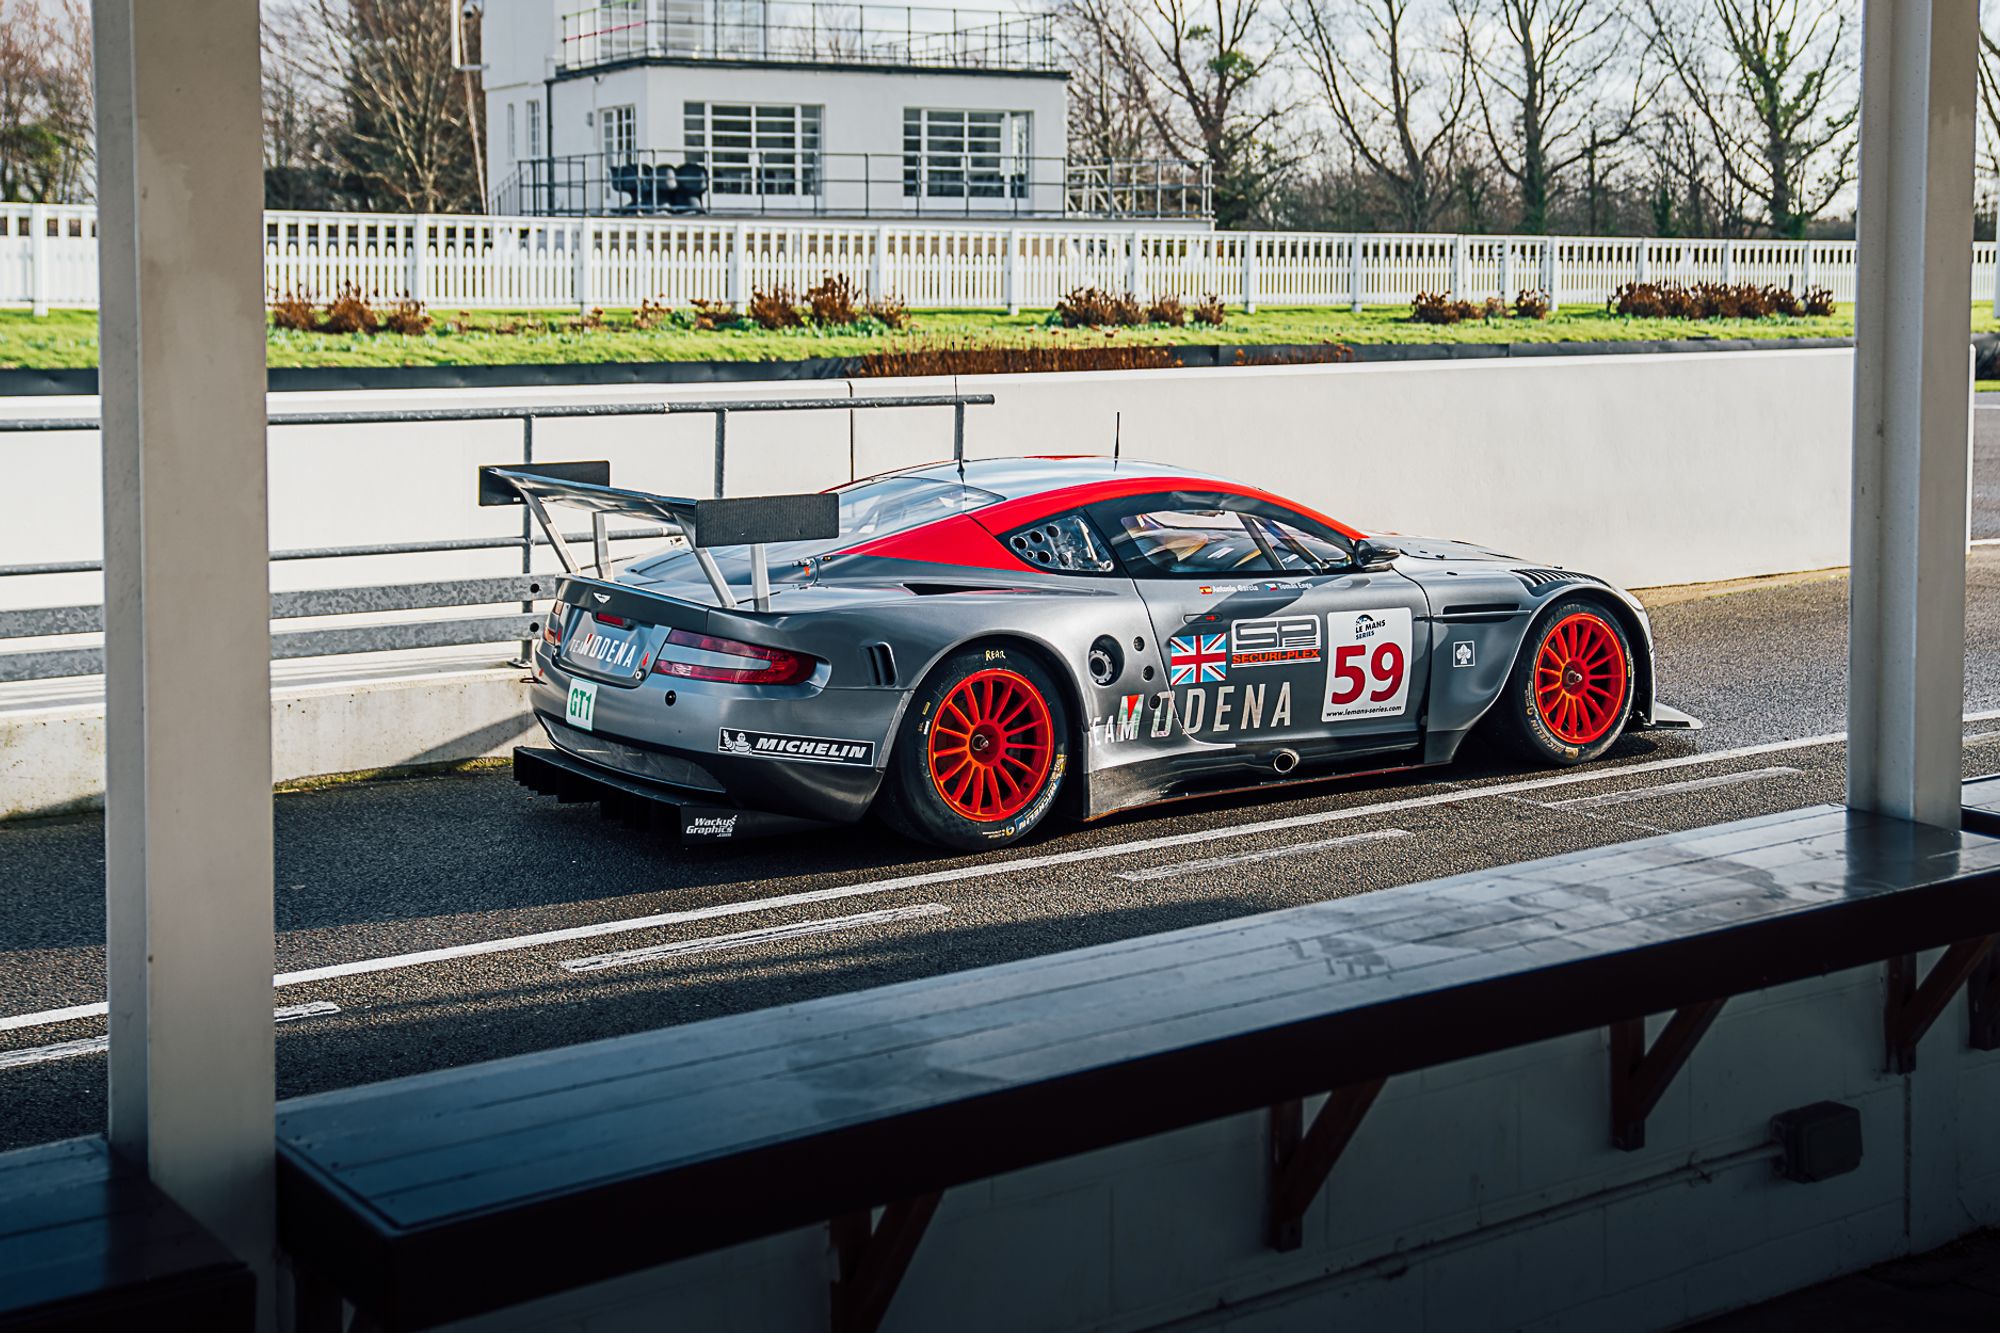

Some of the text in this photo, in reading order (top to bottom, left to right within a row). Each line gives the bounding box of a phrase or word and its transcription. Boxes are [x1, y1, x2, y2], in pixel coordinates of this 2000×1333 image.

[1355, 620, 1386, 634] LE MANS
[1355, 630, 1375, 640] SERIES
[583, 633, 637, 668] MODENA
[985, 650, 1006, 661] REAR
[1232, 649, 1319, 664] SECURI-PLEX
[1331, 642, 1404, 704] 59
[570, 688, 592, 721] GT1
[1326, 706, 1402, 717] www.lemans-series.com
[756, 738, 867, 758] MICHELIN
[695, 817, 734, 828] Wacky
[686, 825, 733, 835] Graphics
